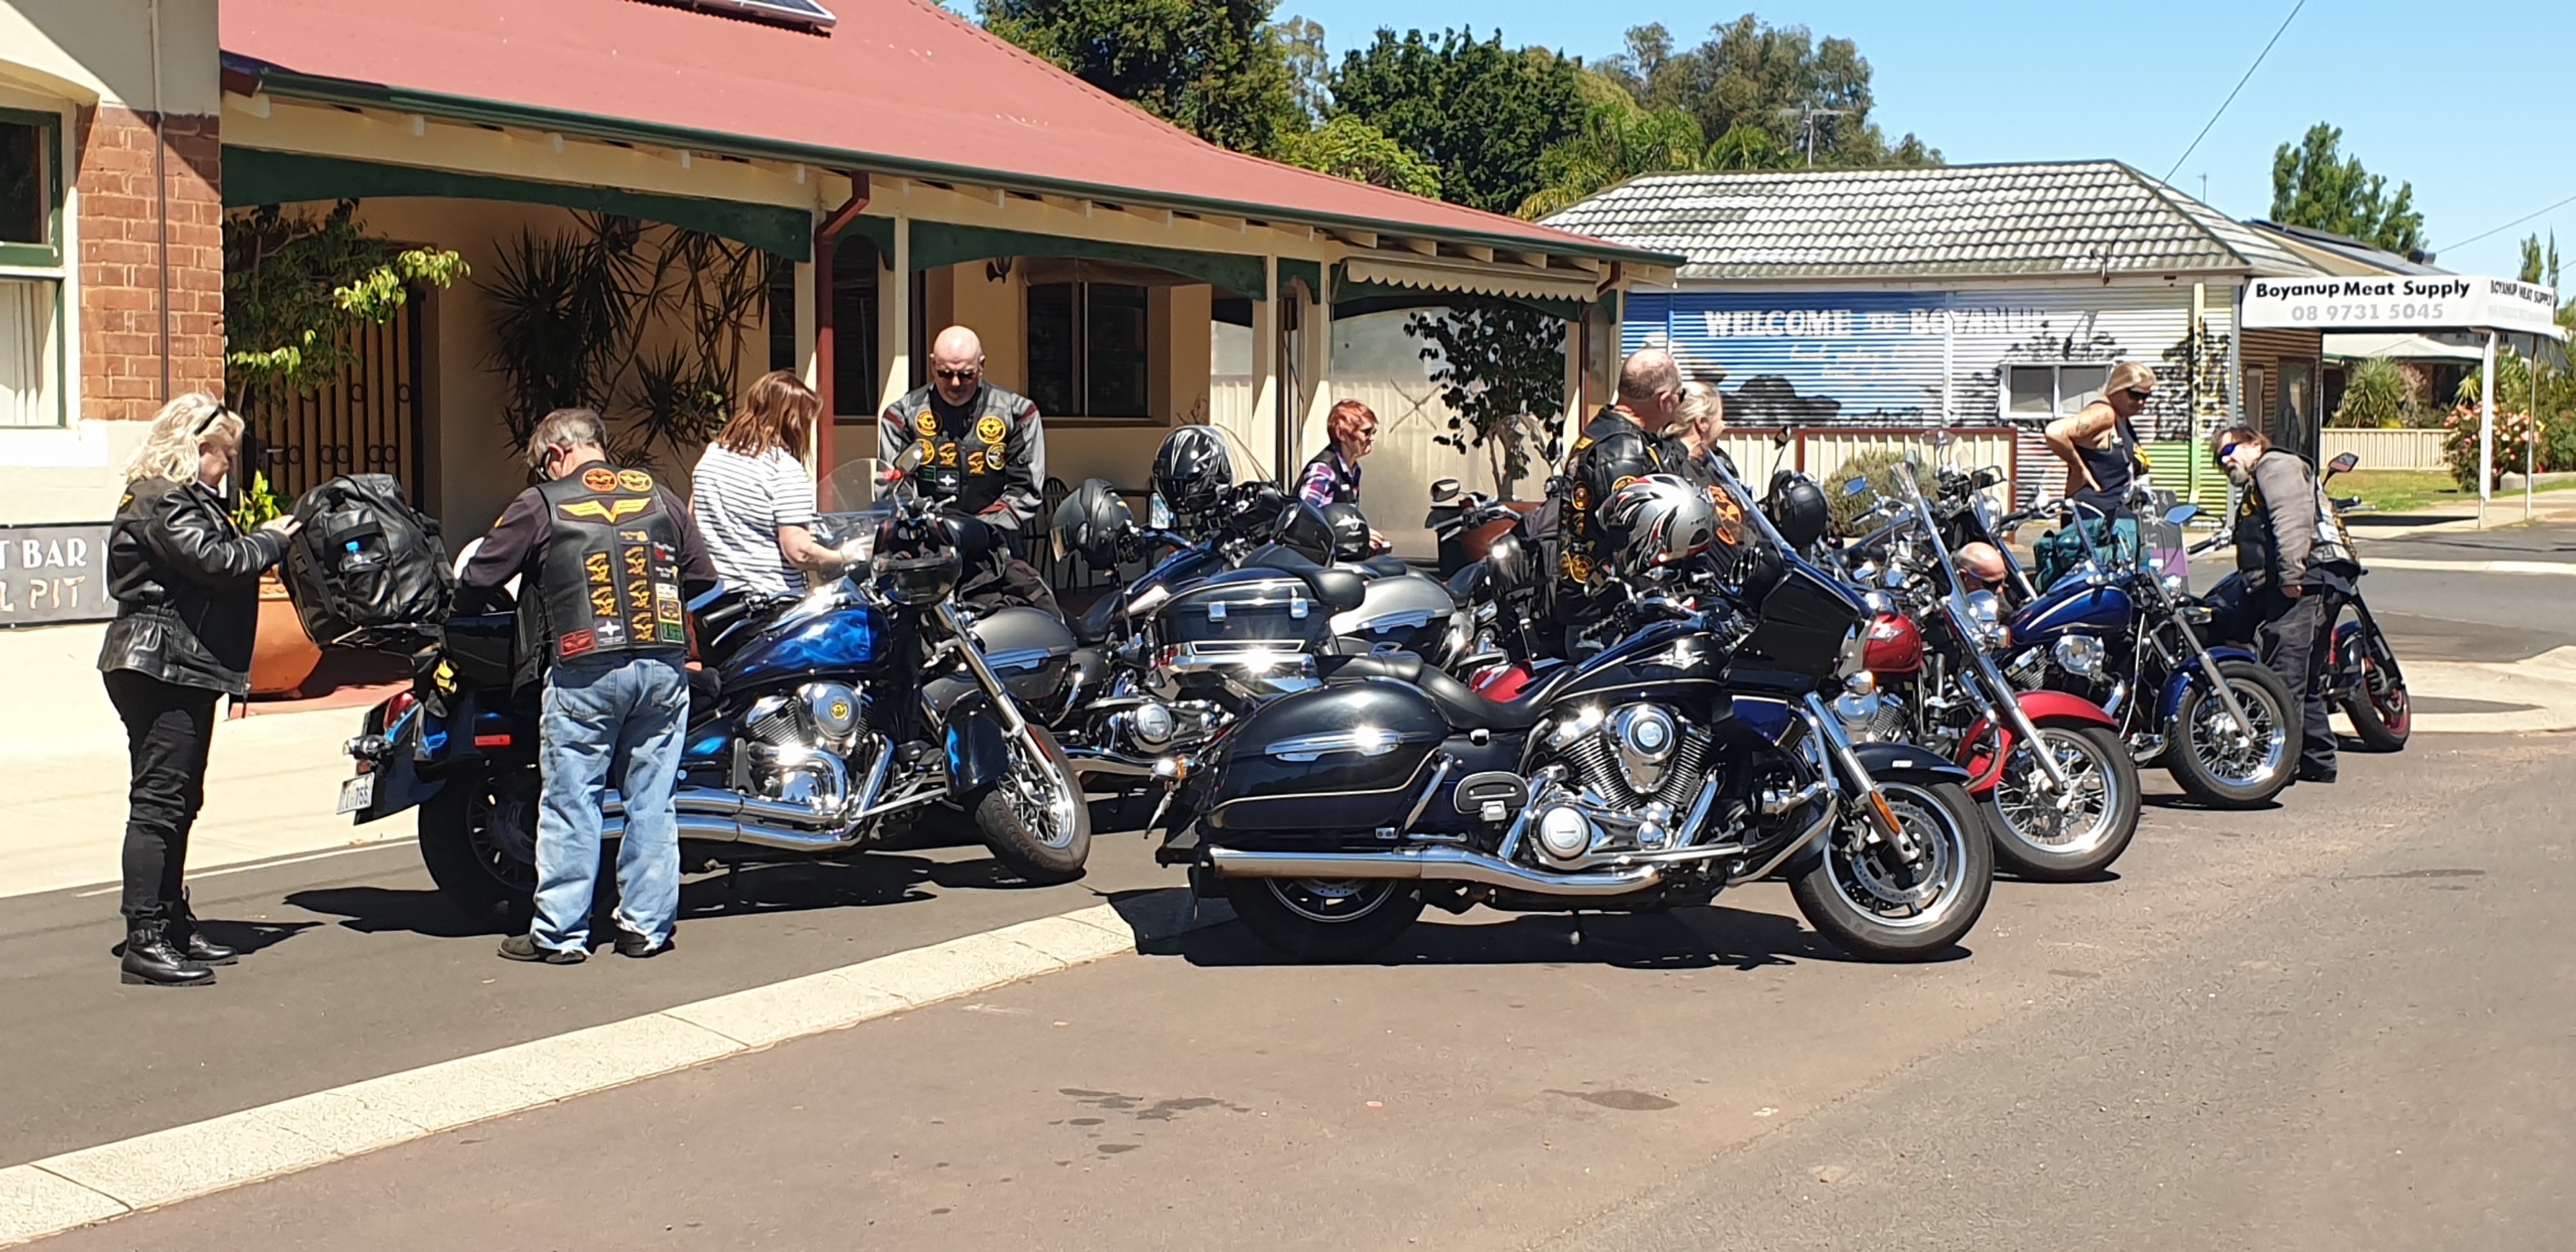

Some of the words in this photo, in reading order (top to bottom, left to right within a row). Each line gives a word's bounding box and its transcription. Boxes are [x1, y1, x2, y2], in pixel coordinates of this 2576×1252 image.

[2257, 282, 2339, 301] Boyanup
[2343, 281, 2395, 296] Meat
[2403, 279, 2470, 298] Supply
[1705, 310, 1851, 336] WELCOME
[2291, 305, 2318, 321] 08
[2326, 303, 2380, 321] 9731
[2389, 302, 2444, 319] 5045
[22, 537, 87, 569] BAR
[30, 575, 85, 610] PIT
